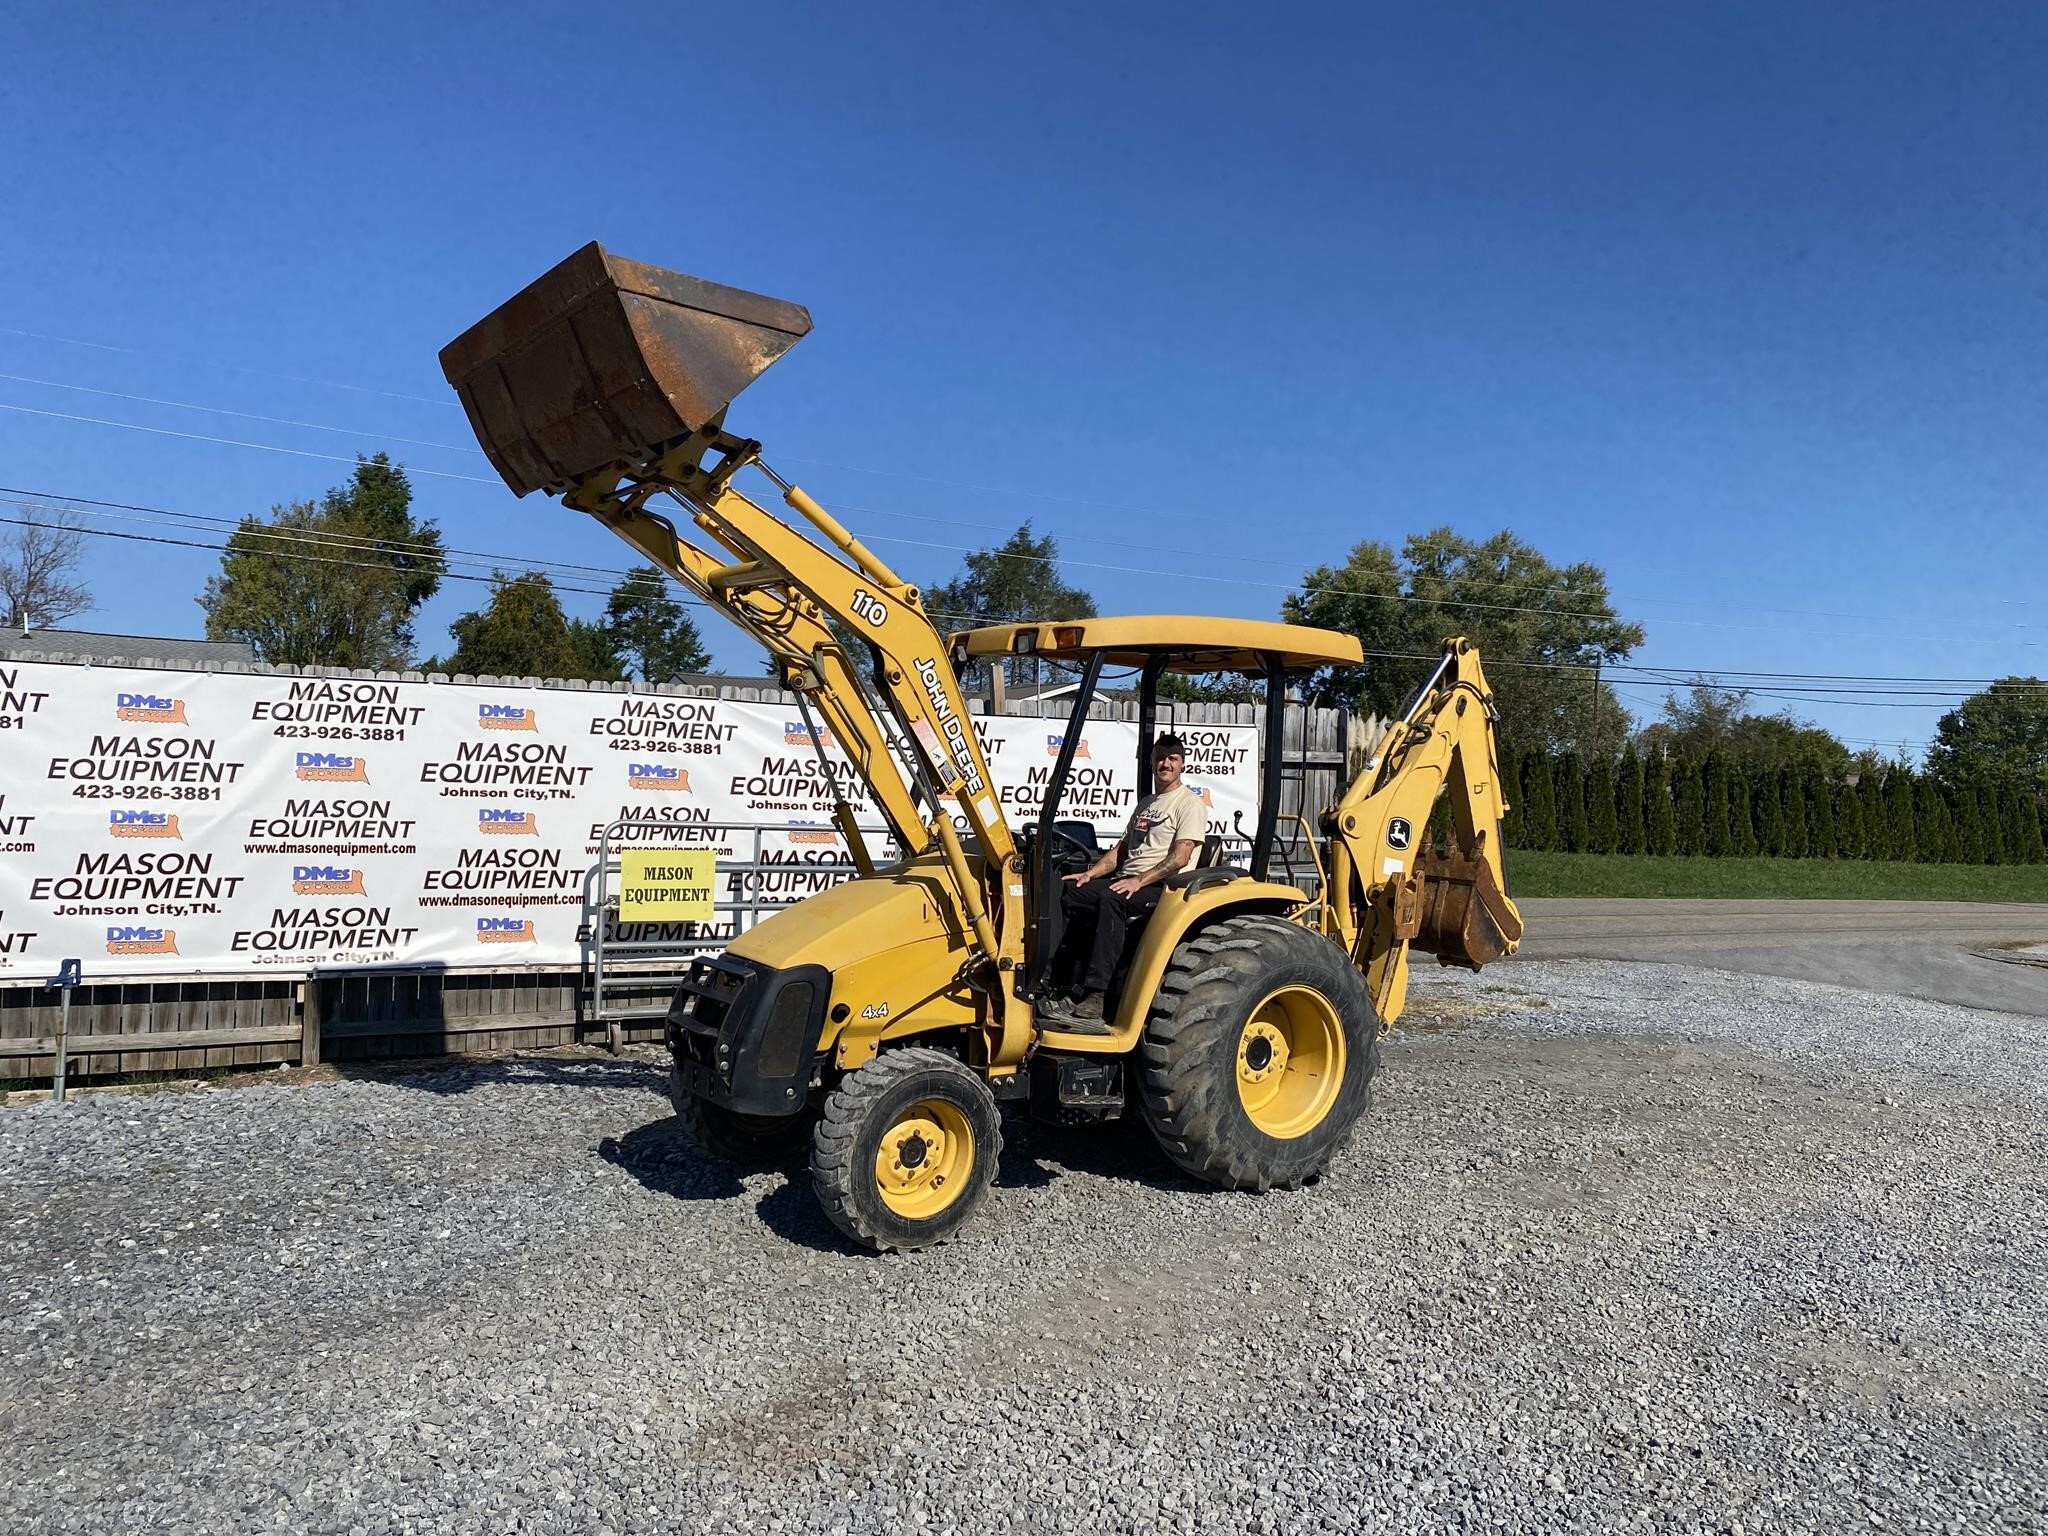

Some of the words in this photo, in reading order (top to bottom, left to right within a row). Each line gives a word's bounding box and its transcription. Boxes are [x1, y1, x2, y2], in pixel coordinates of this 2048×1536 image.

[850, 588, 887, 627] 110
[288, 682, 399, 704] MASON
[251, 702, 425, 725] EQUIPMENT
[620, 700, 715, 722] MASON
[273, 726, 405, 741] 423-926-3881
[589, 718, 738, 742] EQUIPMENT
[913, 657, 950, 723] JOHN
[941, 715, 984, 796] DEERE
[89, 736, 215, 760] MASON
[609, 739, 722, 755] 423-926-3881
[1160, 731, 1230, 746] ASON
[456, 742, 567, 764] MASON
[48, 758, 244, 783] EQUIPMENT
[420, 763, 593, 786] EQUIPMENT
[761, 757, 856, 779] MASON
[1027, 766, 1113, 786] MSON
[72, 785, 221, 801] 423-926-3881
[439, 788, 508, 799] Johnson
[730, 777, 866, 800] EQUIPMEN
[1000, 786, 1134, 806] EQUPMENT
[284, 799, 390, 818] MASON
[619, 806, 710, 822] MASON
[747, 800, 807, 811] Johnson
[1015, 807, 1068, 818] Johon
[249, 819, 415, 838] EQUIPMENT
[244, 842, 416, 856] www.dmasonequipment.com
[458, 849, 560, 868] MASON
[760, 850, 857, 866] MASON
[75, 853, 212, 875] MASON
[644, 867, 693, 880] MASON
[30, 877, 244, 900] EQUIPMENT
[423, 870, 585, 890] EQUIPMENT
[418, 893, 585, 908] www.dmasonequipment.com
[625, 888, 710, 904] EQUIPMENT
[53, 904, 138, 916] Johnson
[271, 907, 390, 928] MASON
[231, 928, 418, 951] EQUIPMENT
[575, 923, 736, 942] EQUIPMENT
[252, 954, 326, 964] Johnson
[862, 1002, 889, 1019] 4x4
